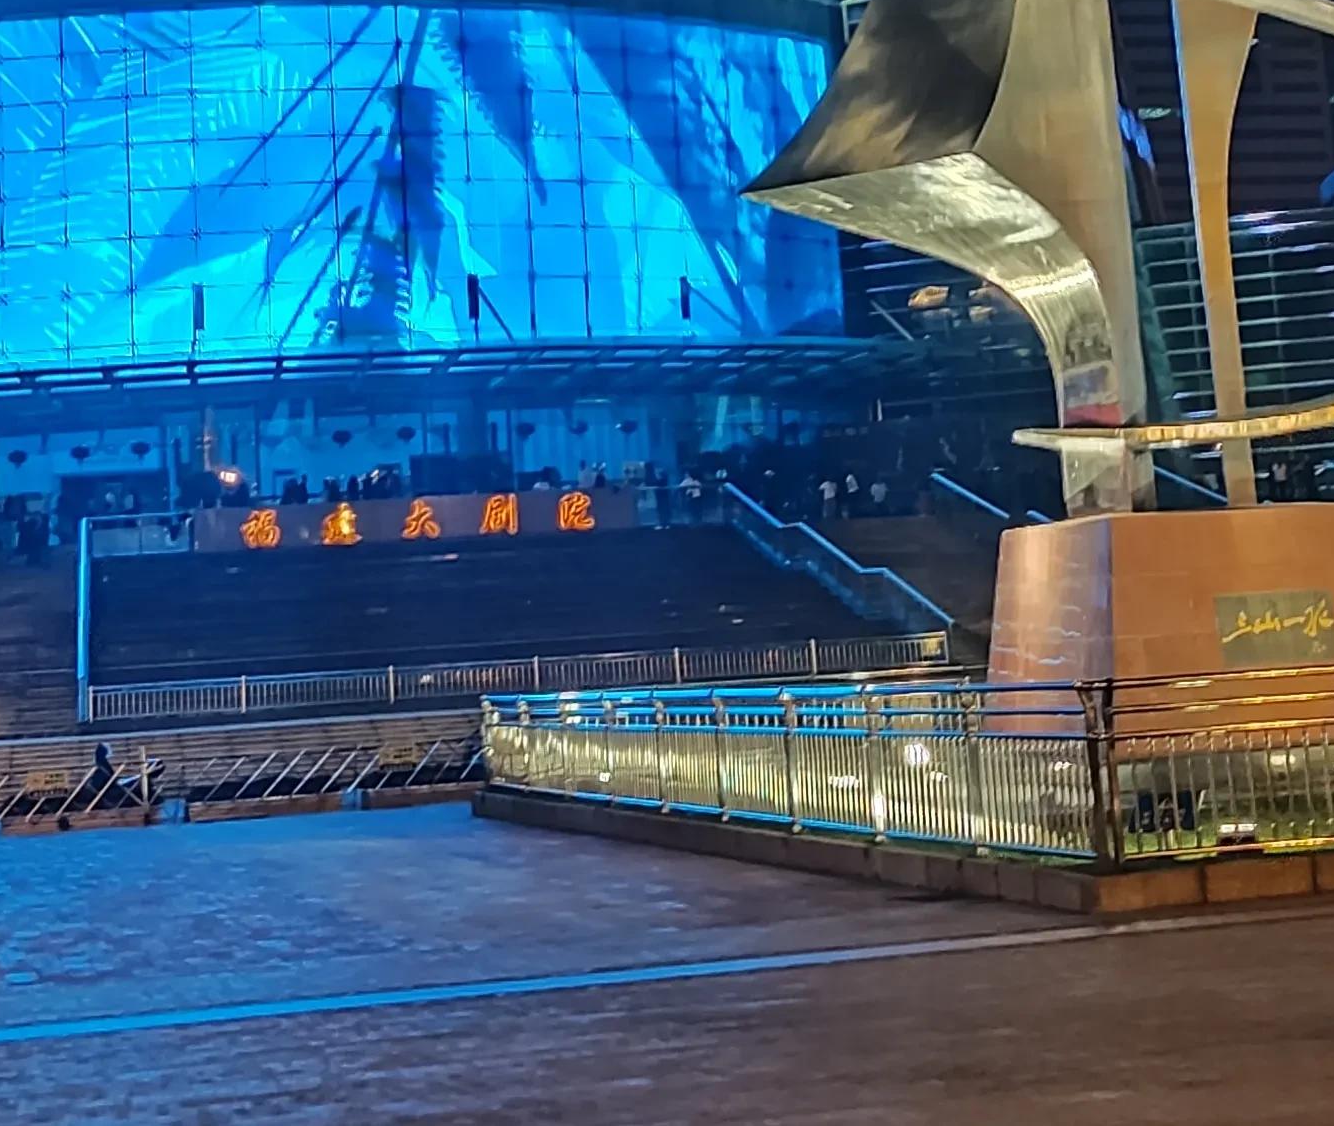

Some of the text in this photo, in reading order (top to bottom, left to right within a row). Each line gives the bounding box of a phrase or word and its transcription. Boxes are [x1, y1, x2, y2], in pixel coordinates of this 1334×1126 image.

[240, 492, 595, 549] 福建大剧院
